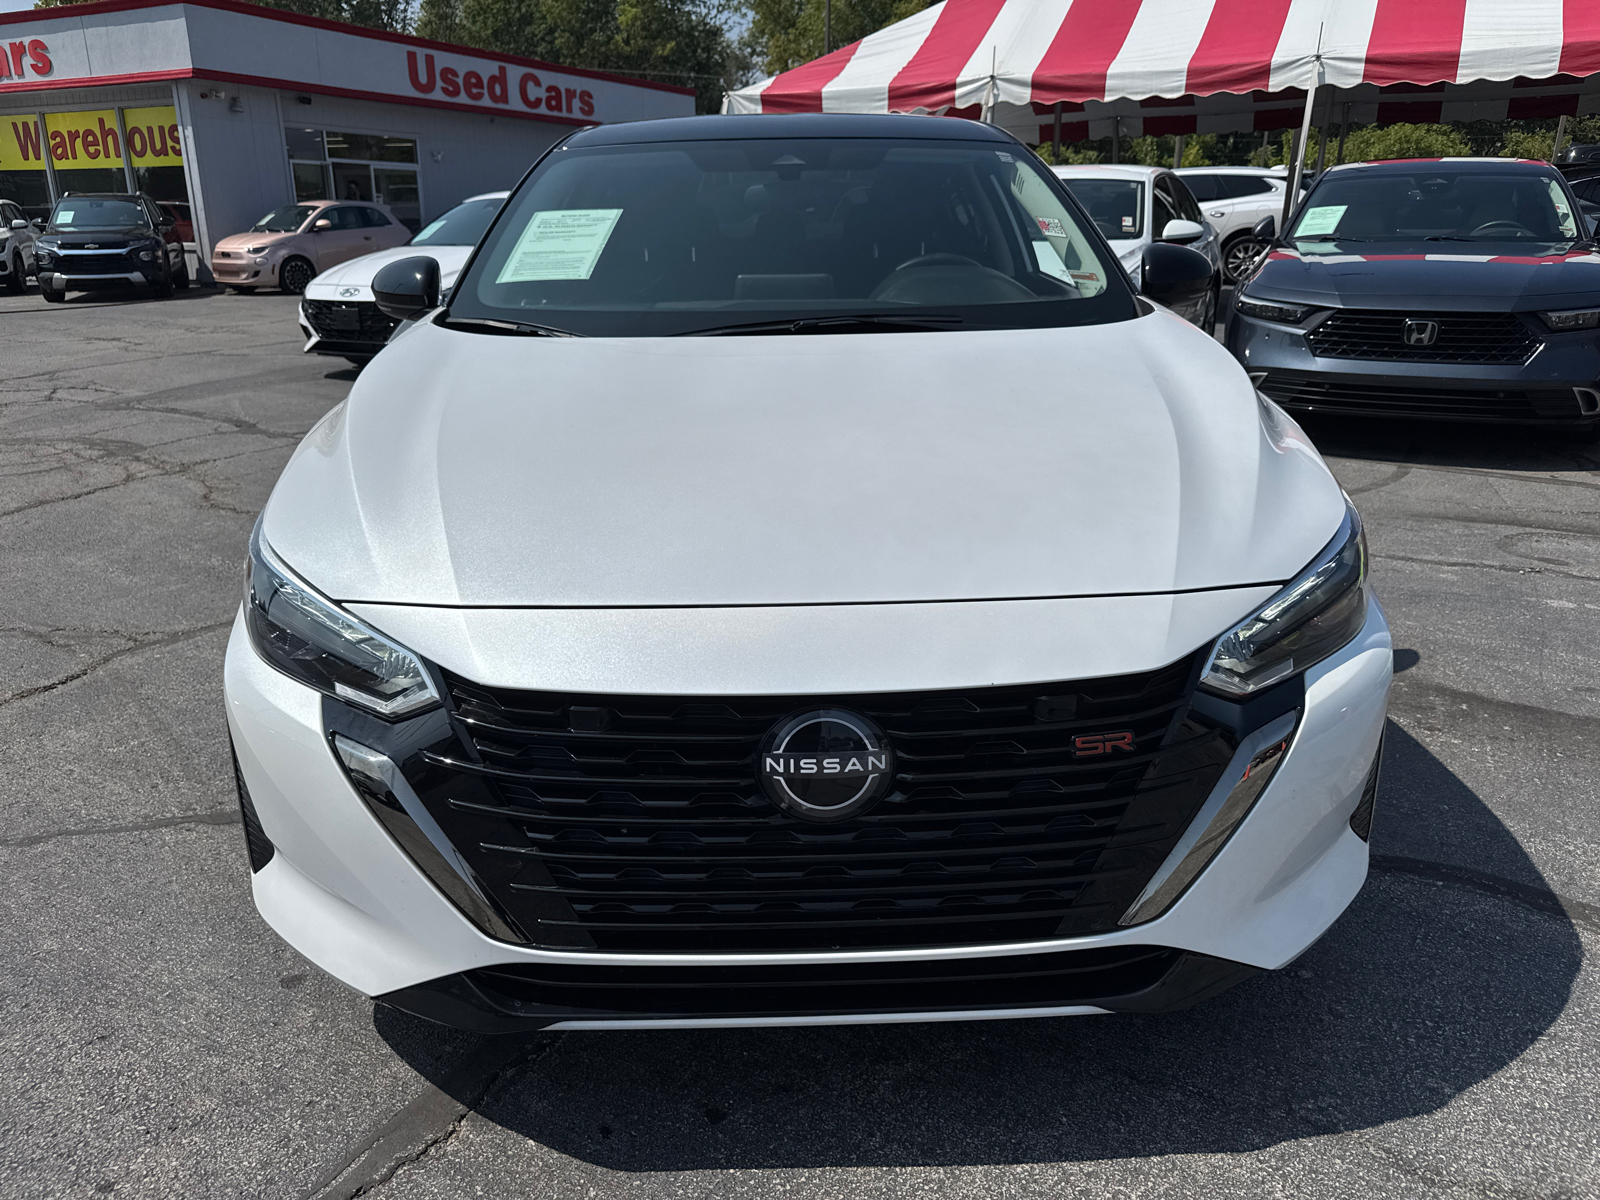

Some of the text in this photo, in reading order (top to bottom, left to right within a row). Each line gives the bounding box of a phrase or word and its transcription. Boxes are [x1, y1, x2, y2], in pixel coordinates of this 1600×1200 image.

[406, 50, 596, 117] Used Cars
[1074, 731, 1135, 757] SR
[765, 753, 887, 774] NISSAN
